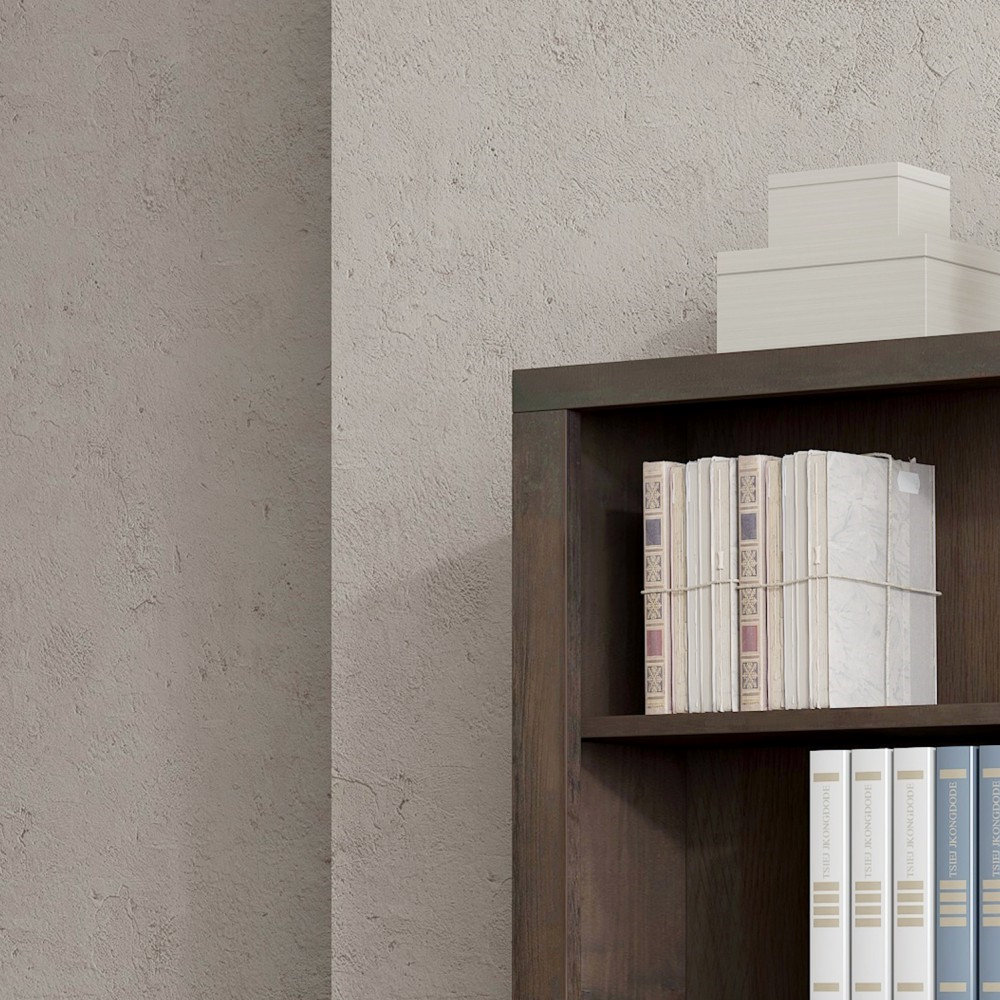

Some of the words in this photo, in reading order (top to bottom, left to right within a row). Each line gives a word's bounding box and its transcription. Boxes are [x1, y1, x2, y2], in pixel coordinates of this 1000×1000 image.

[822, 852, 831, 880] TSIEJ
[864, 852, 873, 879] TSIEJ
[906, 852, 915, 879] TSIEJ
[948, 851, 958, 878] TSIEJ
[991, 851, 1000, 877] TSIEJ
